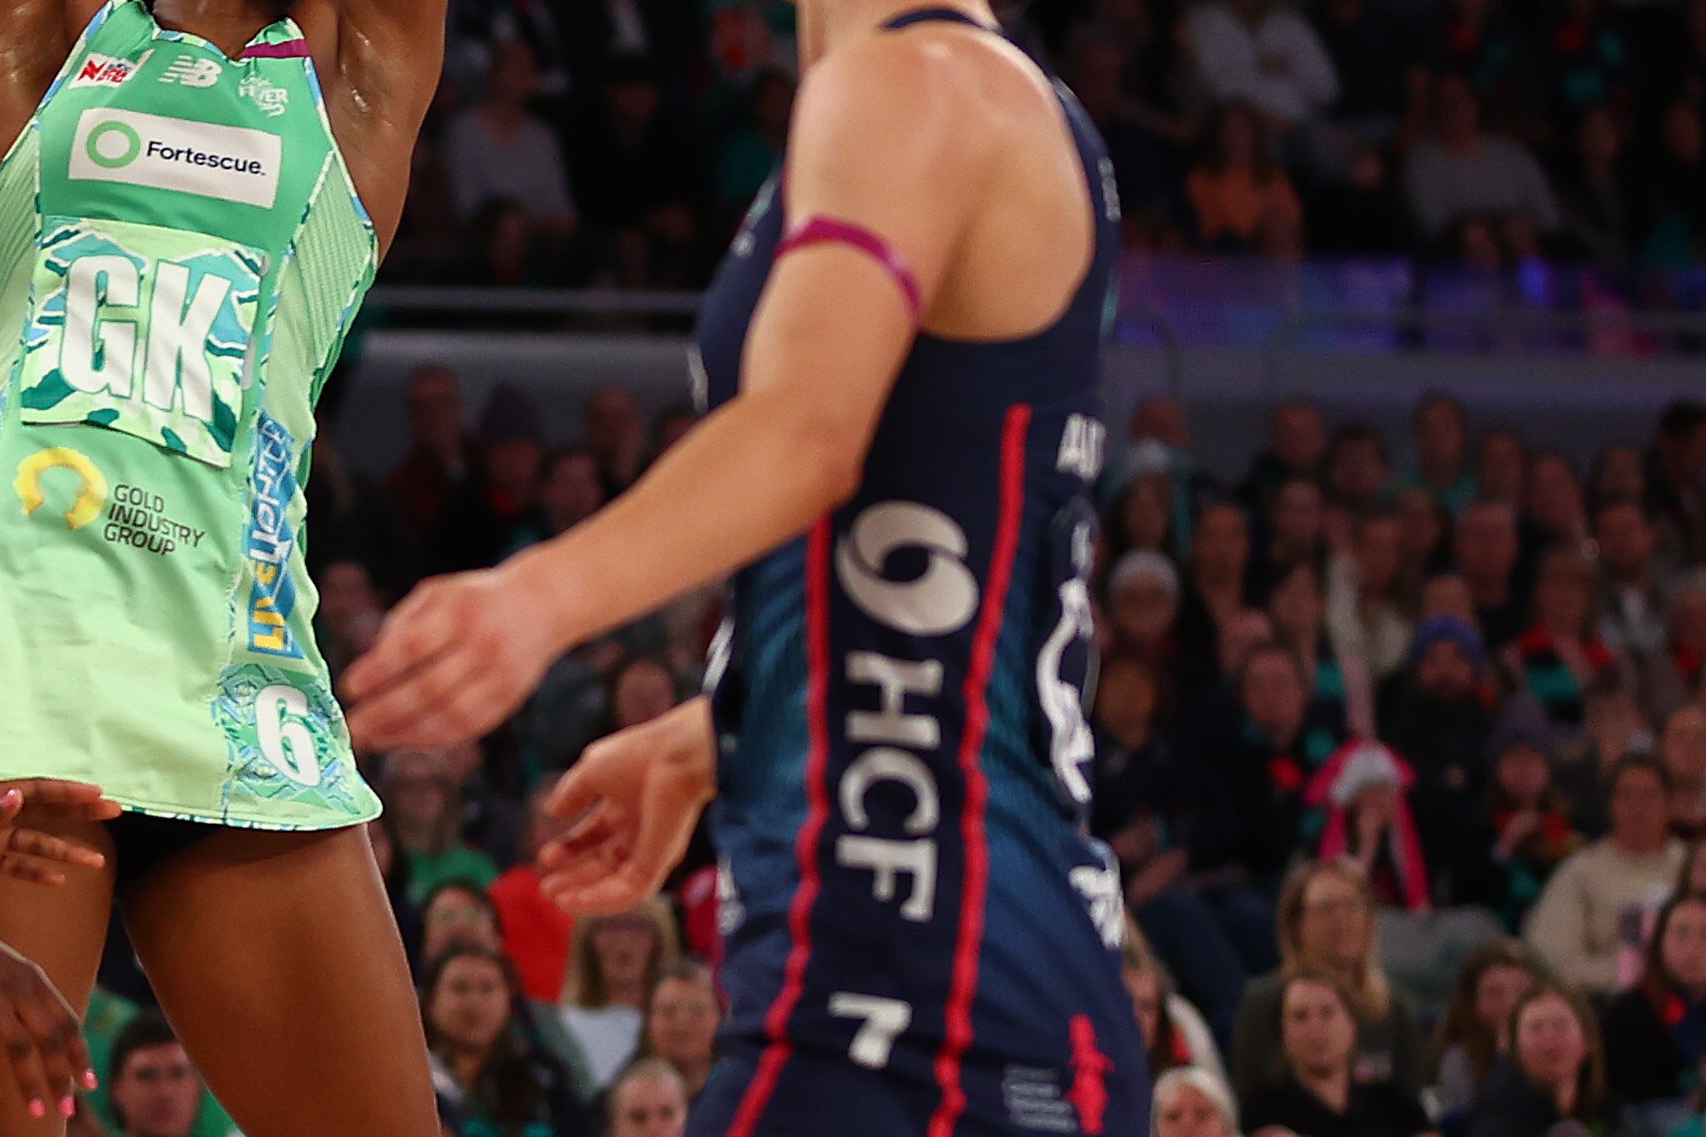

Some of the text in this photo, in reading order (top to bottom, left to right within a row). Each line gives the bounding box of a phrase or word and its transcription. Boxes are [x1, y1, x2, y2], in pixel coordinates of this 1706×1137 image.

[58, 253, 231, 422] GK
[104, 523, 175, 556] GROUP
[108, 502, 205, 548] INDUSTRY
[114, 484, 165, 513] GOLD
[255, 684, 322, 787] 6
[836, 651, 943, 920] HCF
[826, 989, 913, 1071] 7
